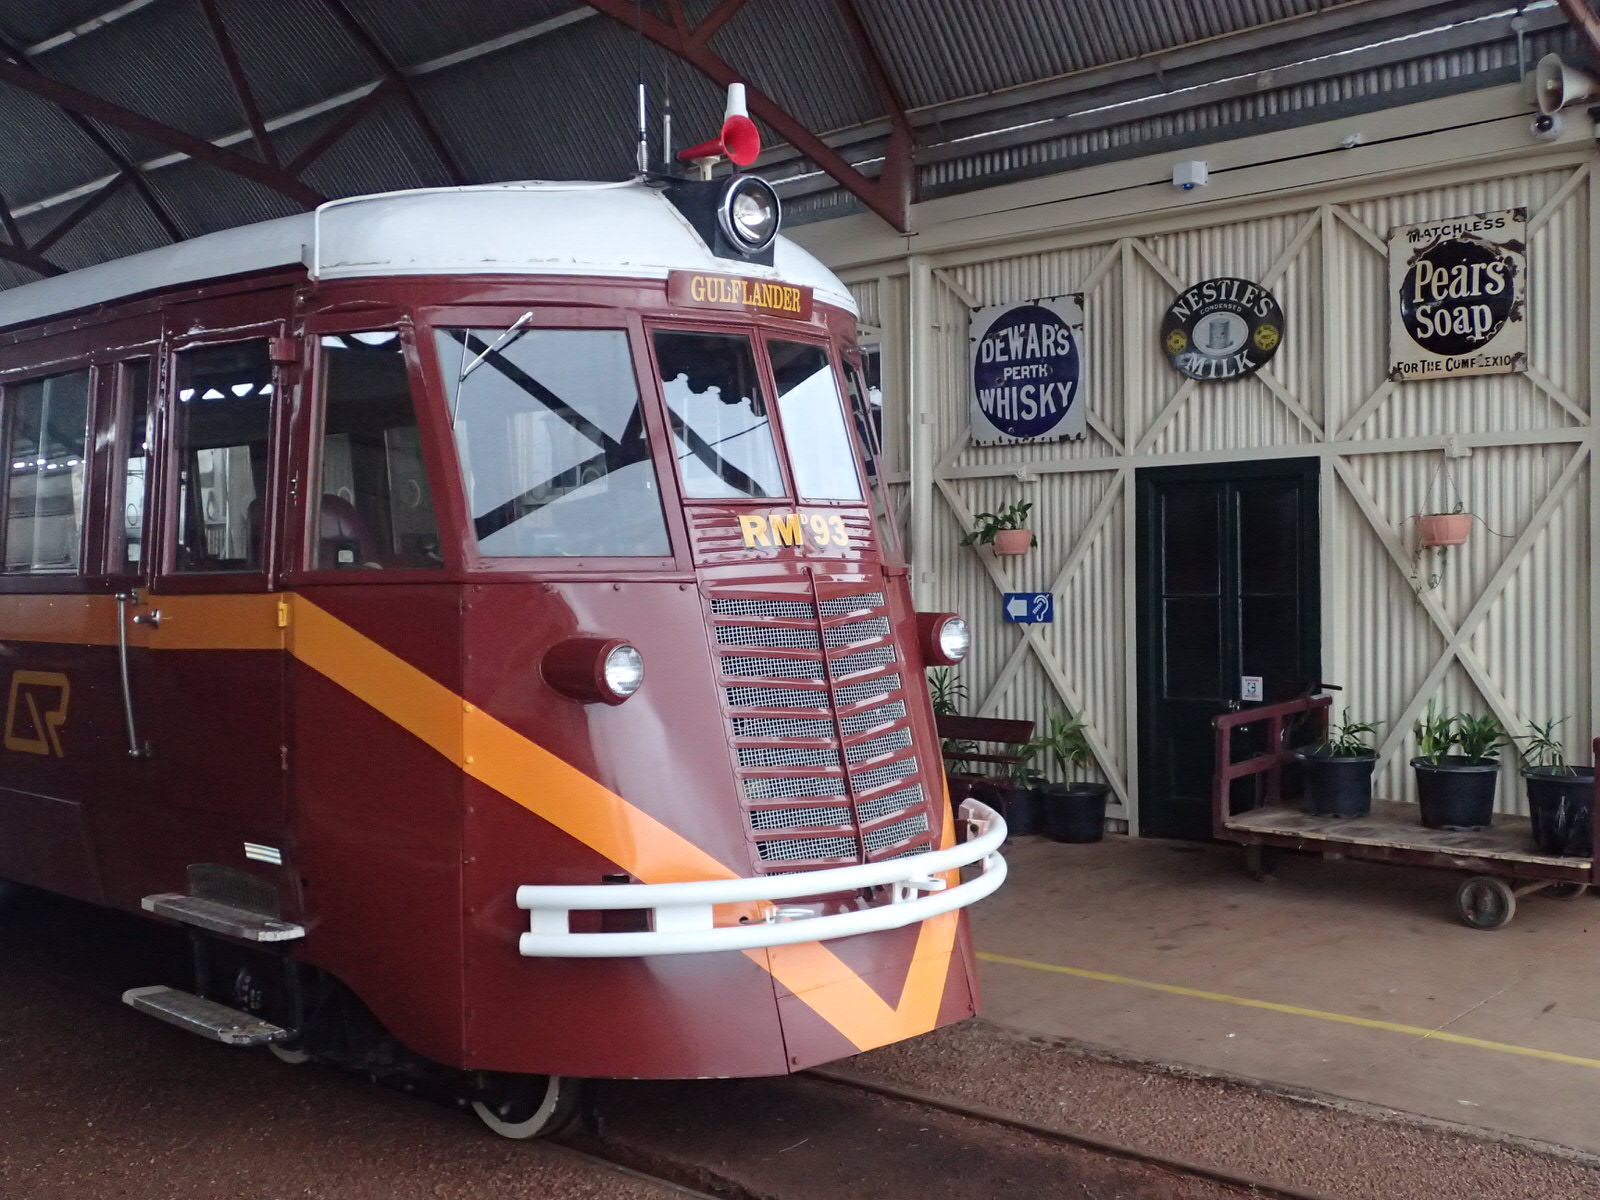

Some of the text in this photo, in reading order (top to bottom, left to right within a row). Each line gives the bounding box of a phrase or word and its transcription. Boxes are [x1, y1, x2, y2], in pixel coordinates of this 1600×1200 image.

[1406, 218, 1505, 243] MATCHLESS
[1200, 303, 1242, 315] CONDENSED
[1416, 304, 1493, 340] Soap
[981, 323, 1070, 364] DEWAR'S
[1003, 363, 1049, 380] PERTH
[1184, 349, 1256, 378] MILK
[980, 381, 1073, 421] WHISKY
